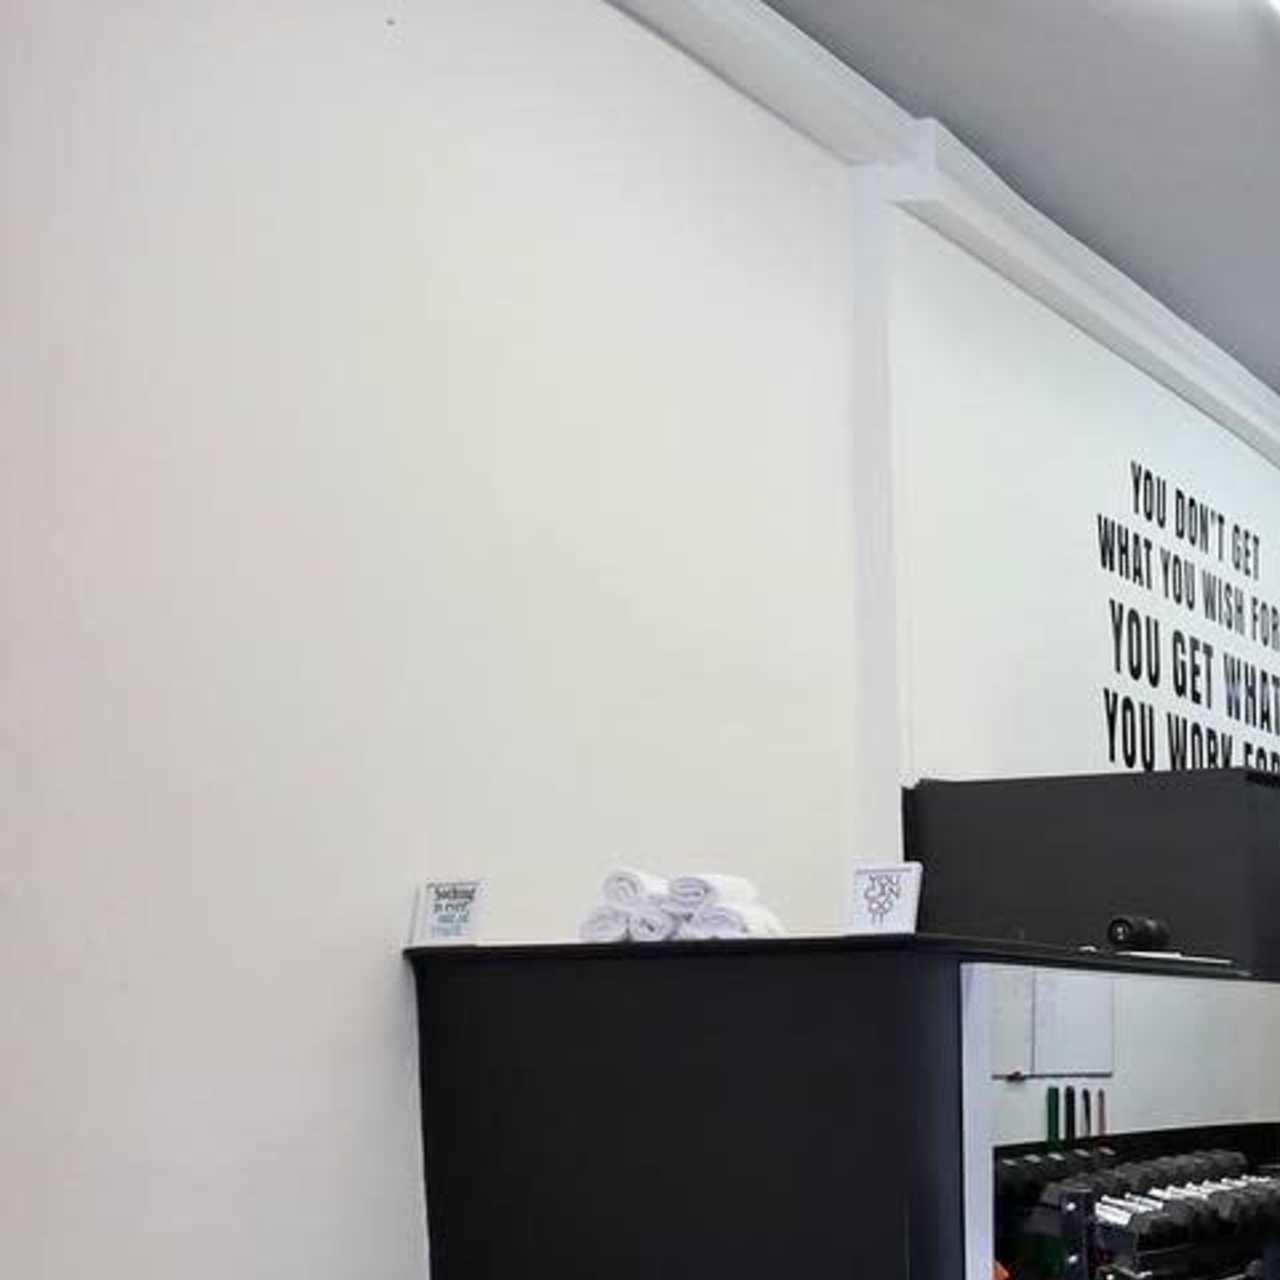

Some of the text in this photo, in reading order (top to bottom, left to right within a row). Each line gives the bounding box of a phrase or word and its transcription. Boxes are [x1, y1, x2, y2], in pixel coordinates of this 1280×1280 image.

[1097, 512, 1153, 590] WHAT
[1159, 546, 1196, 612] YOU
[1202, 568, 1245, 637] WISH
[1130, 461, 1260, 581] YOU DON'T GET
[1109, 598, 1280, 737] YOU GET WHAT
[1104, 688, 1155, 773] YOU
